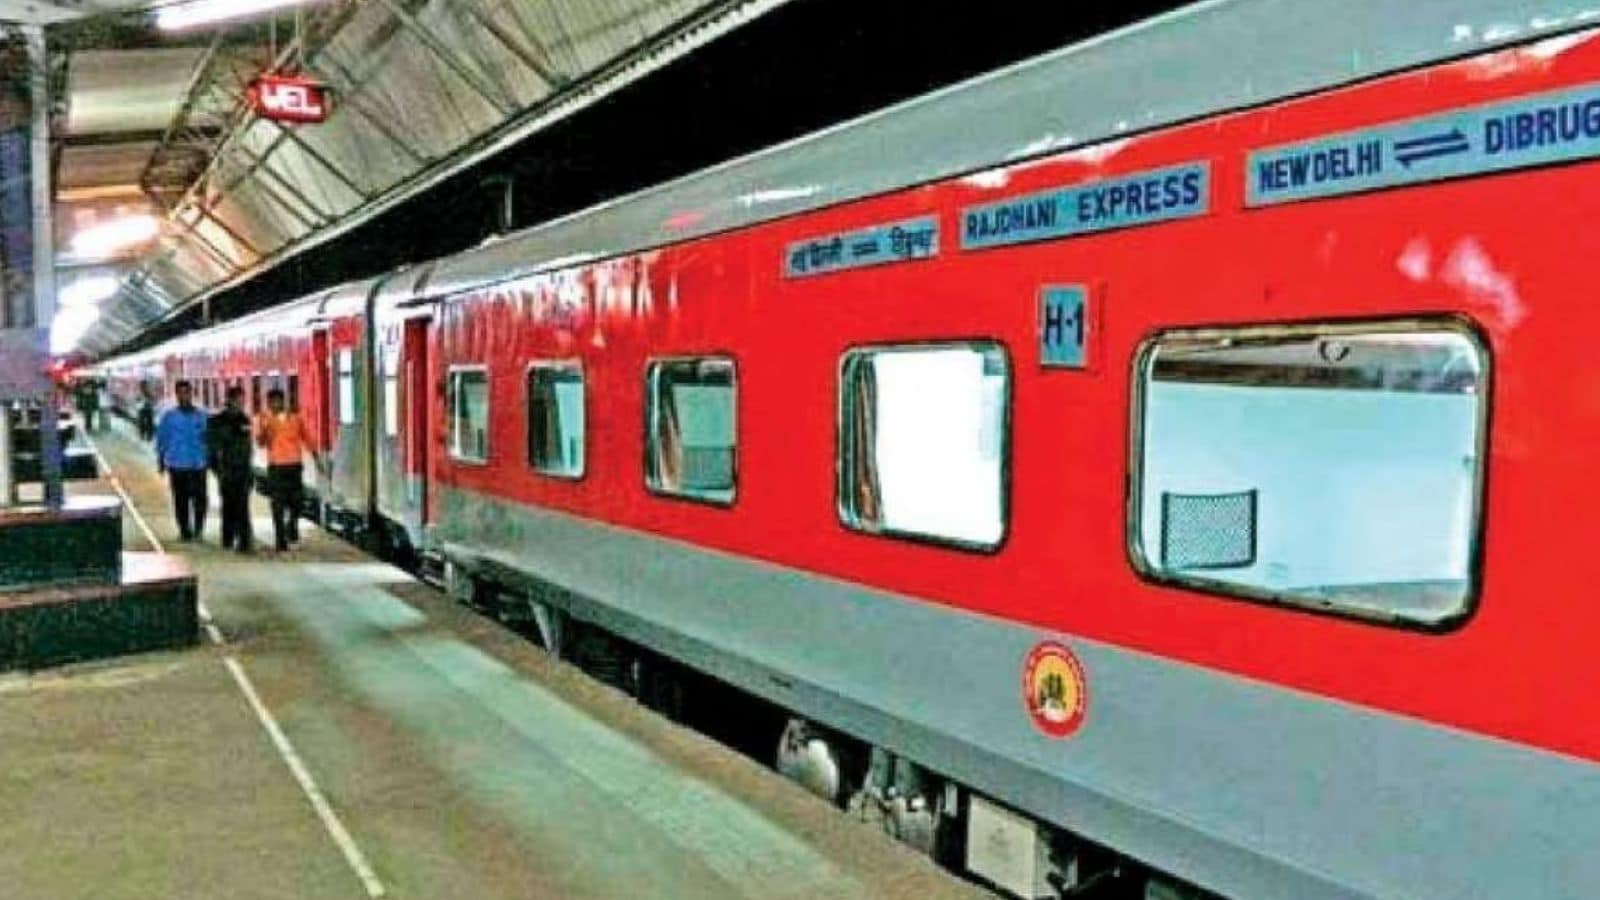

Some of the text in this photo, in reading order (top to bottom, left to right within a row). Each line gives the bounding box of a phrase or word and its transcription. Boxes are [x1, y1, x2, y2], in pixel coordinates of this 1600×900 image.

[1258, 99, 1600, 193] NEW DELHI DIBRUG
[966, 172, 1200, 240] RAJDHANI EXPRESS
[1044, 302, 1084, 347] H-1
